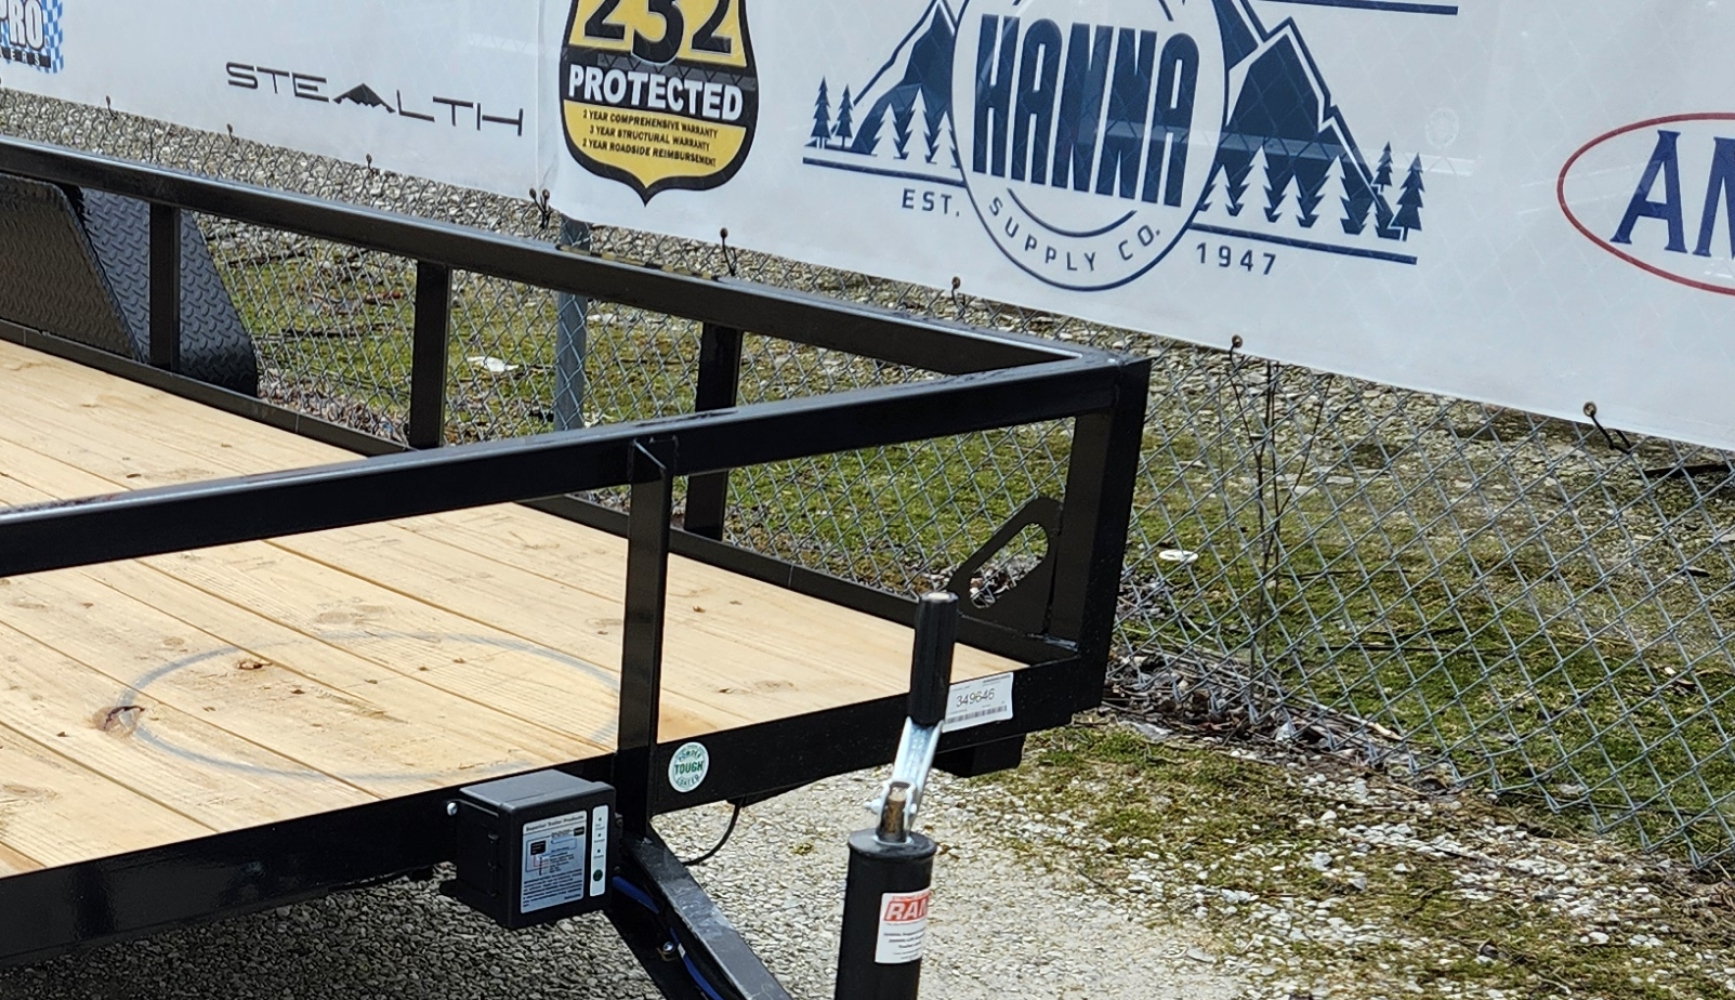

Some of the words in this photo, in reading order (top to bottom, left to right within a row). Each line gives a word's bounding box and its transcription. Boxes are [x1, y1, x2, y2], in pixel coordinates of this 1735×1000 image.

[225, 61, 524, 137] STEALTH
[568, 63, 744, 122] PROTECTED
[589, 110, 609, 120] YEAR
[609, 112, 681, 131] COMPREHENSIVE
[681, 123, 719, 139] WARRANTY
[972, 13, 1201, 209] HANNA
[588, 138, 608, 150] YEAR
[609, 141, 651, 157] ROADSIDE
[652, 147, 717, 167] REIMBURSEMENT
[596, 125, 616, 136] YEAR
[617, 128, 670, 145] STRUCTURAL
[672, 136, 711, 152] WARRANTY
[901, 188, 961, 218] EST.
[988, 196, 1097, 272] SUPPLY
[1117, 224, 1161, 262] CO.
[1195, 241, 1277, 277] 1947
[674, 760, 705, 775] TOUGH
